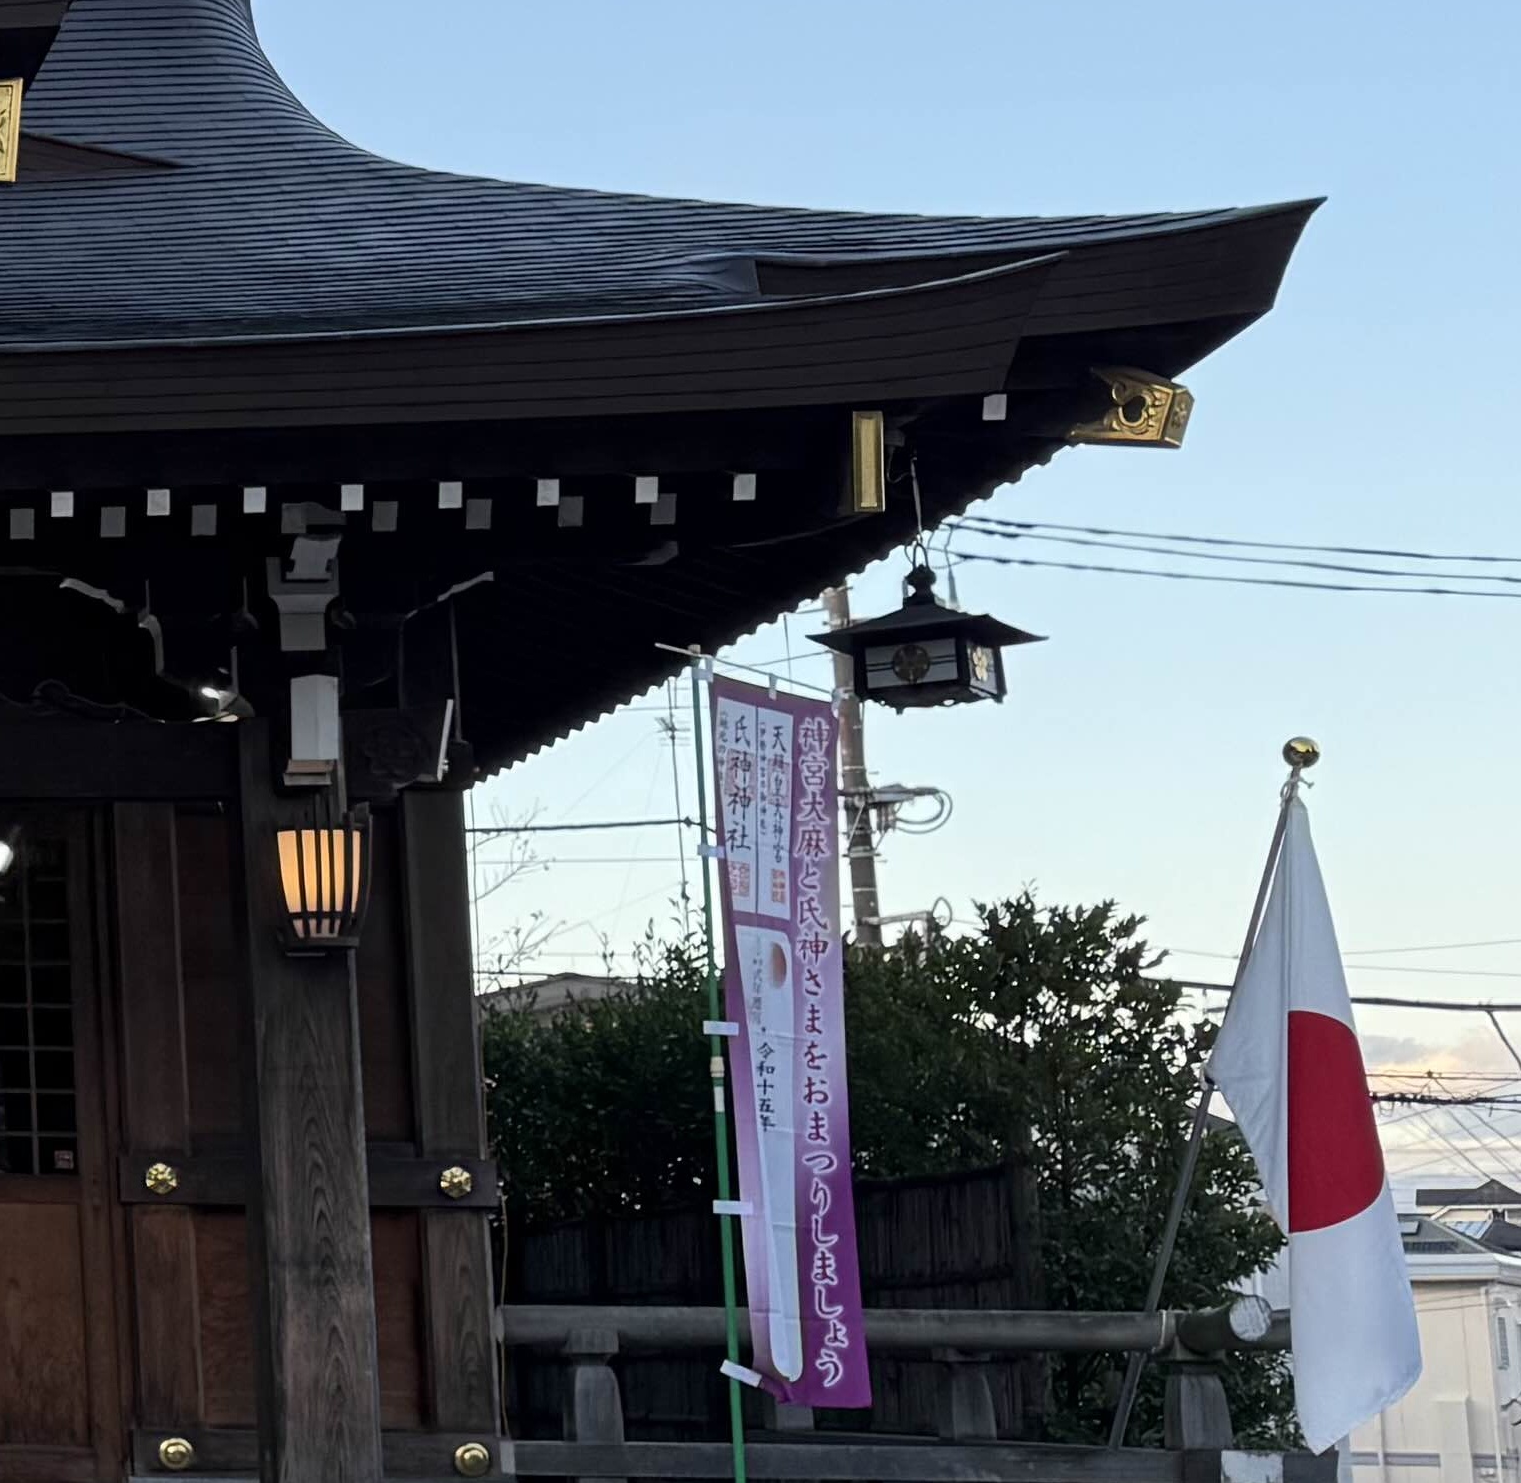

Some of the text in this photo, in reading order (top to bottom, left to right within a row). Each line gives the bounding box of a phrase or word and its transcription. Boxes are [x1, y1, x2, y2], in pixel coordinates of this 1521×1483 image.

[726, 714, 752, 854] 氏神神社
[793, 716, 849, 1388] 神宮大麻と氏神さまをおまつりしましょう
